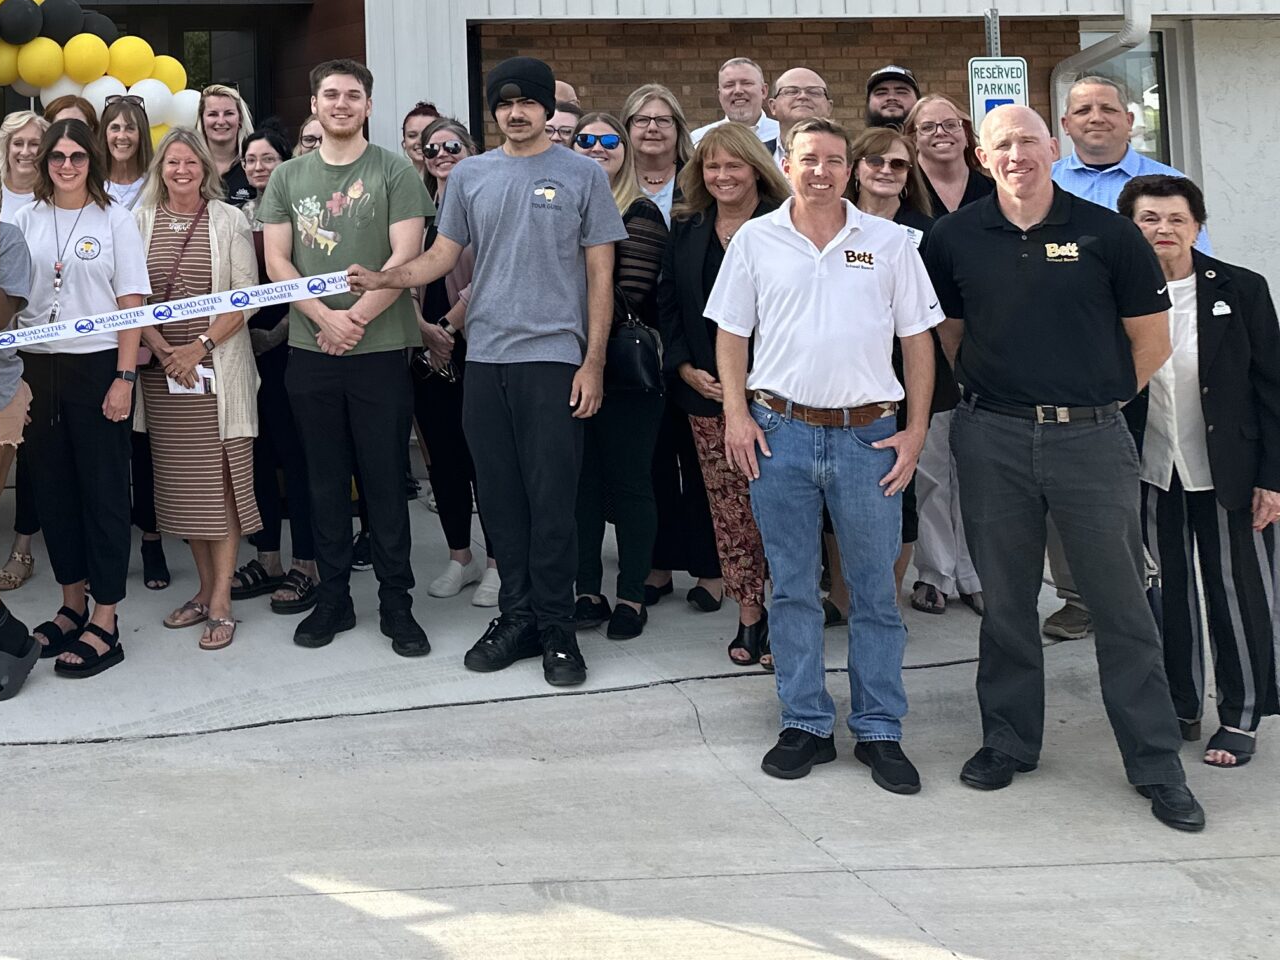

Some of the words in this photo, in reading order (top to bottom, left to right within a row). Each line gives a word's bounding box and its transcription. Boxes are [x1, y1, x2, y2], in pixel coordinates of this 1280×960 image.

[973, 67, 1023, 79] RESERVED
[977, 83, 1021, 95] PARKING
[1044, 242, 1079, 257] Bett
[844, 250, 874, 265] Bett
[250, 288, 274, 298] QUAD
[275, 283, 299, 293] CITIES
[173, 301, 197, 311] QUAD
[197, 296, 222, 306] CITIES
[258, 292, 293, 303] CHAMBER
[181, 305, 216, 315] CHAMBER
[95, 315, 119, 324] QUAD
[120, 310, 145, 320] CITIES
[103, 319, 138, 329] CHAMBER
[17, 328, 40, 337] QUAD
[41, 324, 67, 333] CITIES
[24, 332, 60, 341] CHAMBER
